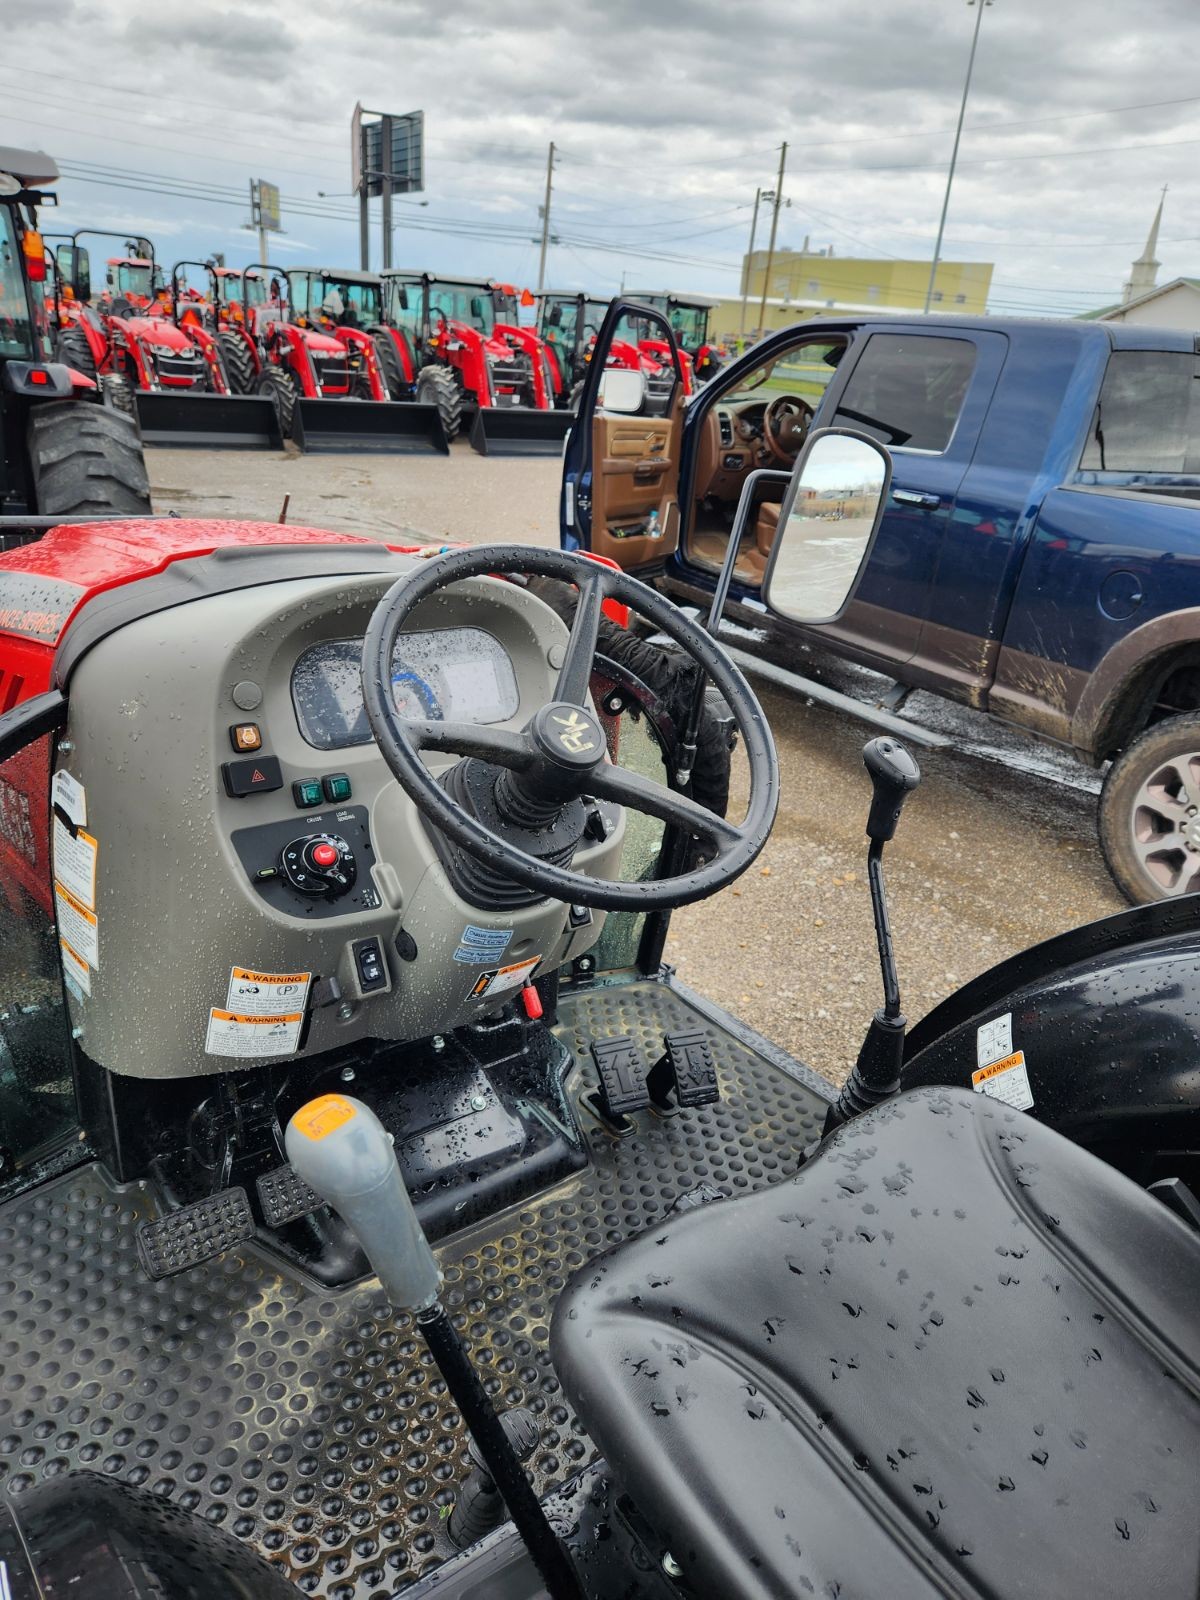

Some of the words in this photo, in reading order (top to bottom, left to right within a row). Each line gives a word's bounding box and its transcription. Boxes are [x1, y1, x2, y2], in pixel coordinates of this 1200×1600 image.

[18, 610, 61, 634] SERIES
[335, 810, 348, 818] LOAD
[306, 815, 323, 824] CRUISE
[252, 974, 303, 984] WARNING
[244, 1016, 287, 1024] WARNING
[986, 1056, 1018, 1077] WARNING
